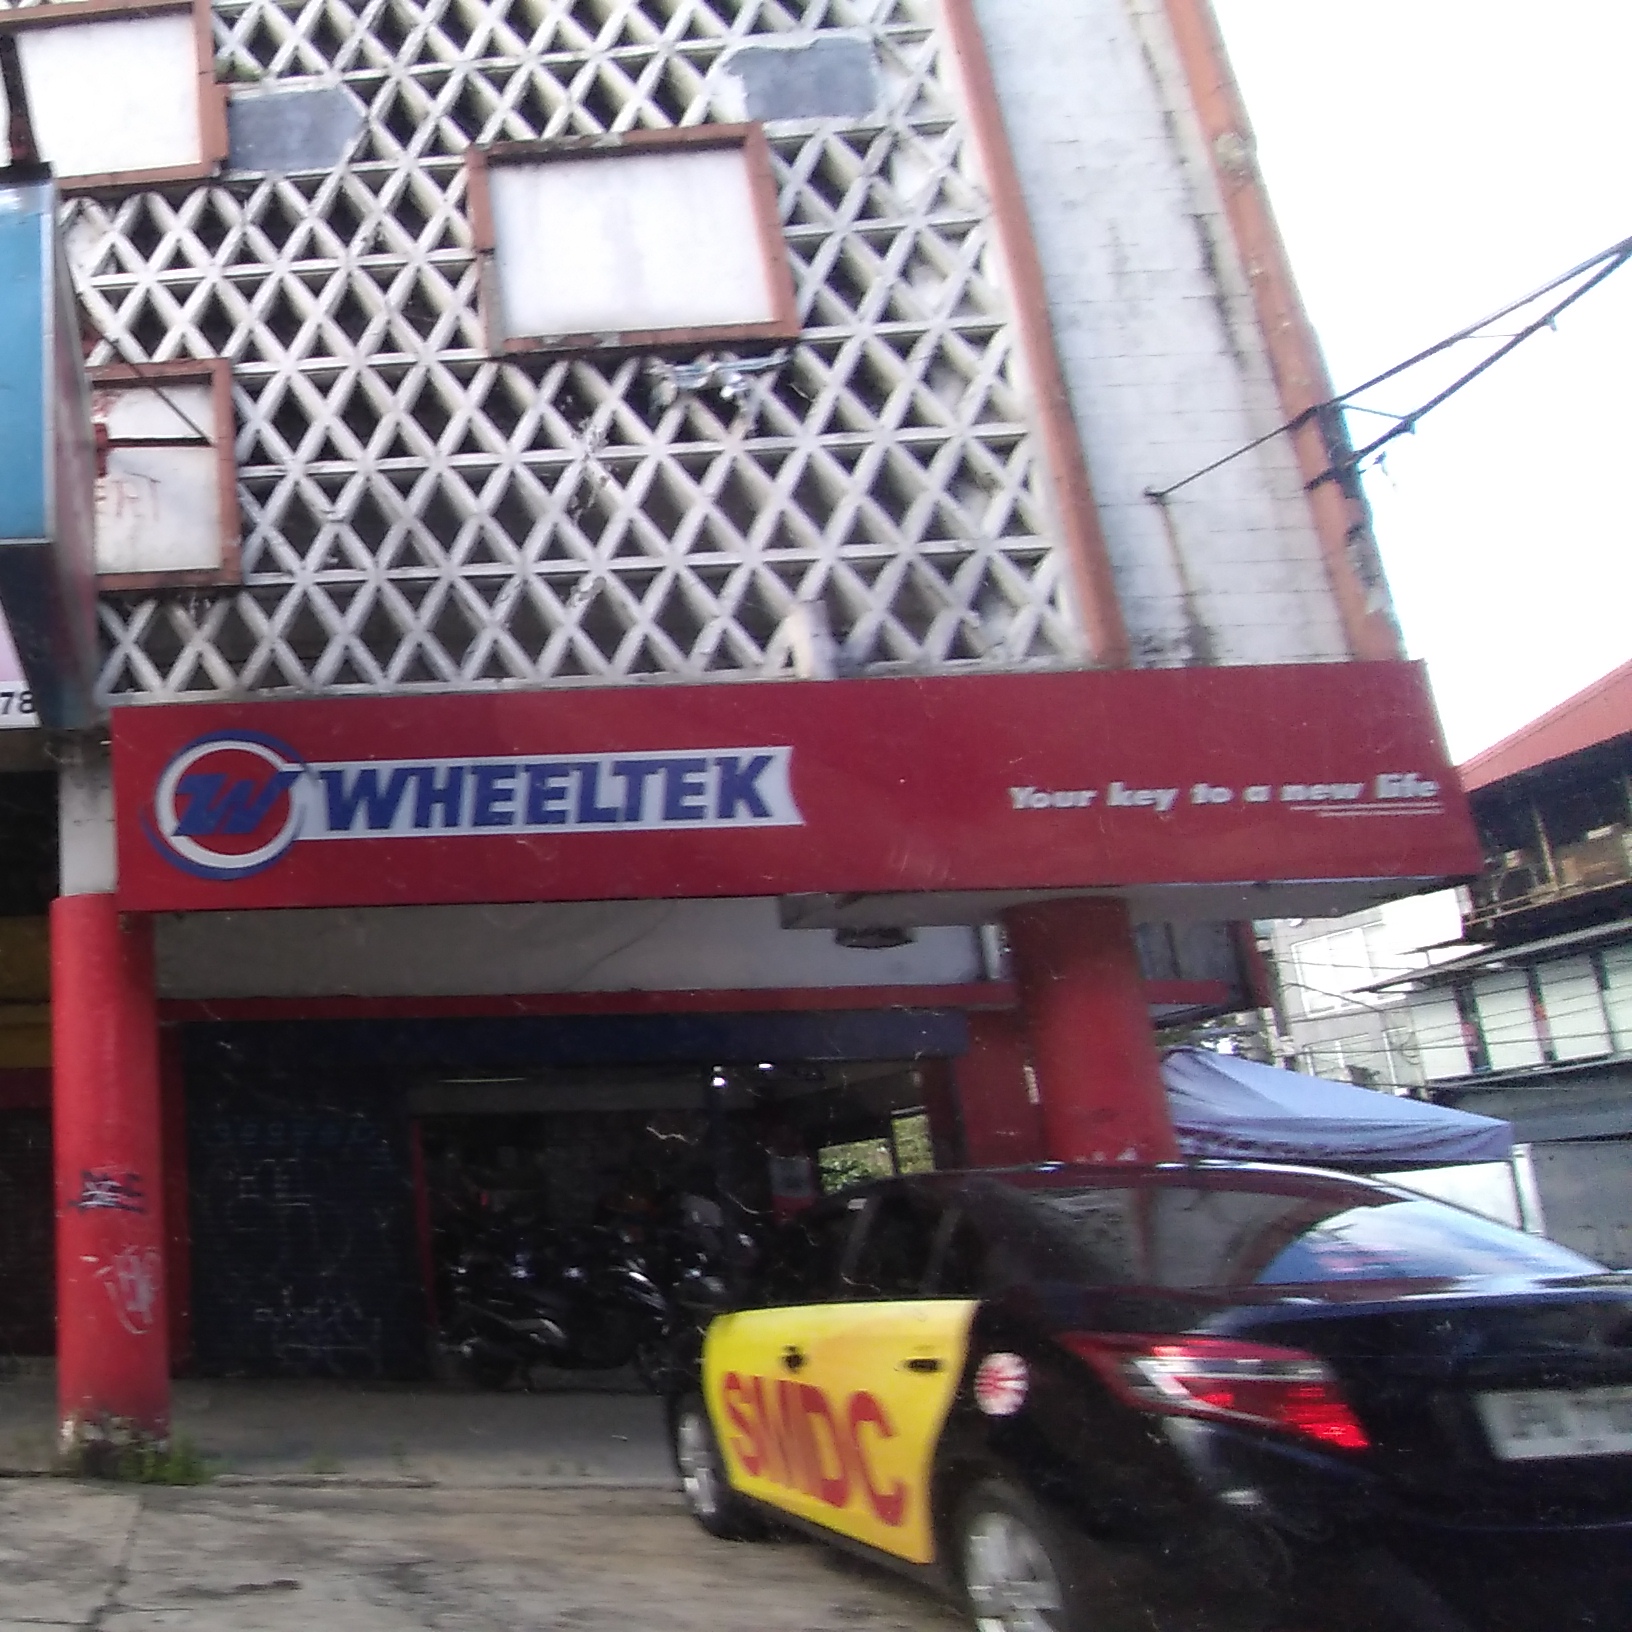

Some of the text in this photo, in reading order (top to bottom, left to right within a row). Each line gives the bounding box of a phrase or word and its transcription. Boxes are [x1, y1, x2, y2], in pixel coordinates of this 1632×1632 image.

[318, 753, 776, 833] WHEELTEK
[1009, 772, 1440, 812] Your key to a new life
[724, 1371, 908, 1527] SMDC
